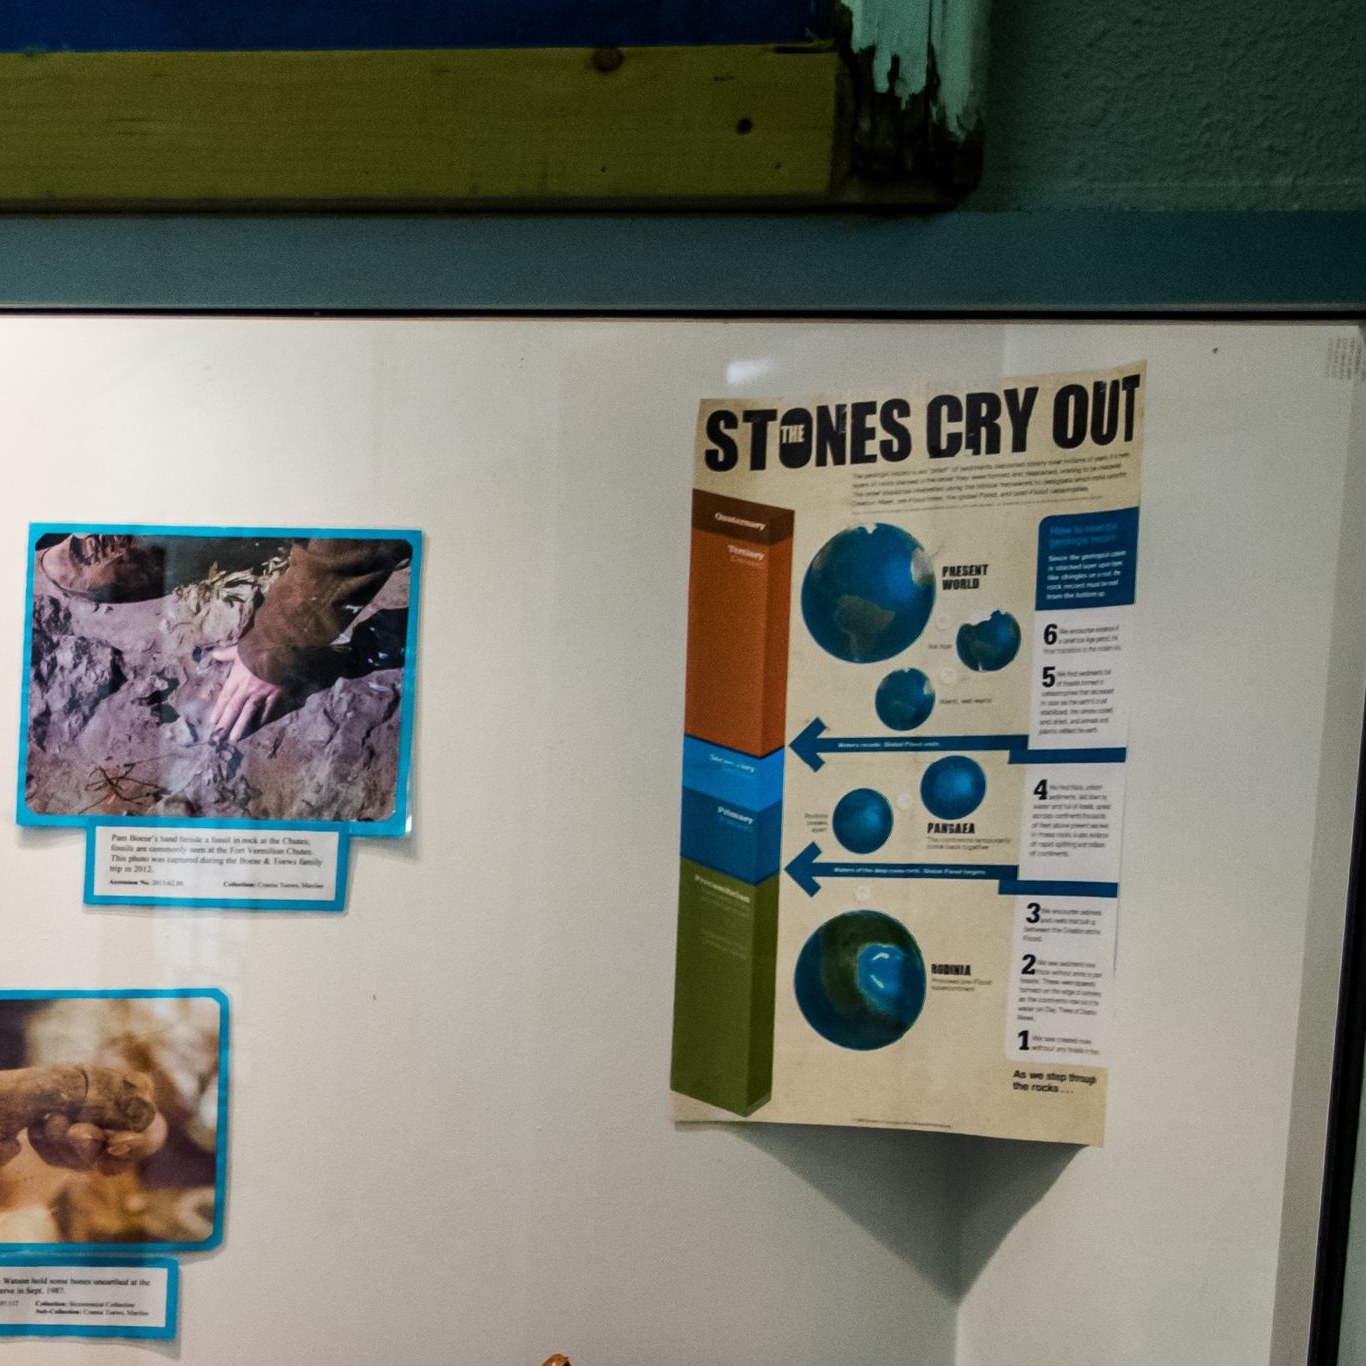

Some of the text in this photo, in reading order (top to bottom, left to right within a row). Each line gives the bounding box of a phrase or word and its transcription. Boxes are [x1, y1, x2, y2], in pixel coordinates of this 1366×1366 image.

[705, 374, 1140, 472] STONES CRY OUT
[780, 424, 804, 443] THE
[942, 564, 989, 577] PRESENT
[942, 578, 979, 590] WORLD
[1044, 624, 1058, 645] 6
[1042, 666, 1056, 687] 5
[1033, 779, 1048, 800] 4
[927, 823, 975, 834] PANGAEA
[1026, 902, 1041, 923] 3
[1021, 954, 1036, 974] 2
[1018, 1030, 1029, 1050] 1
